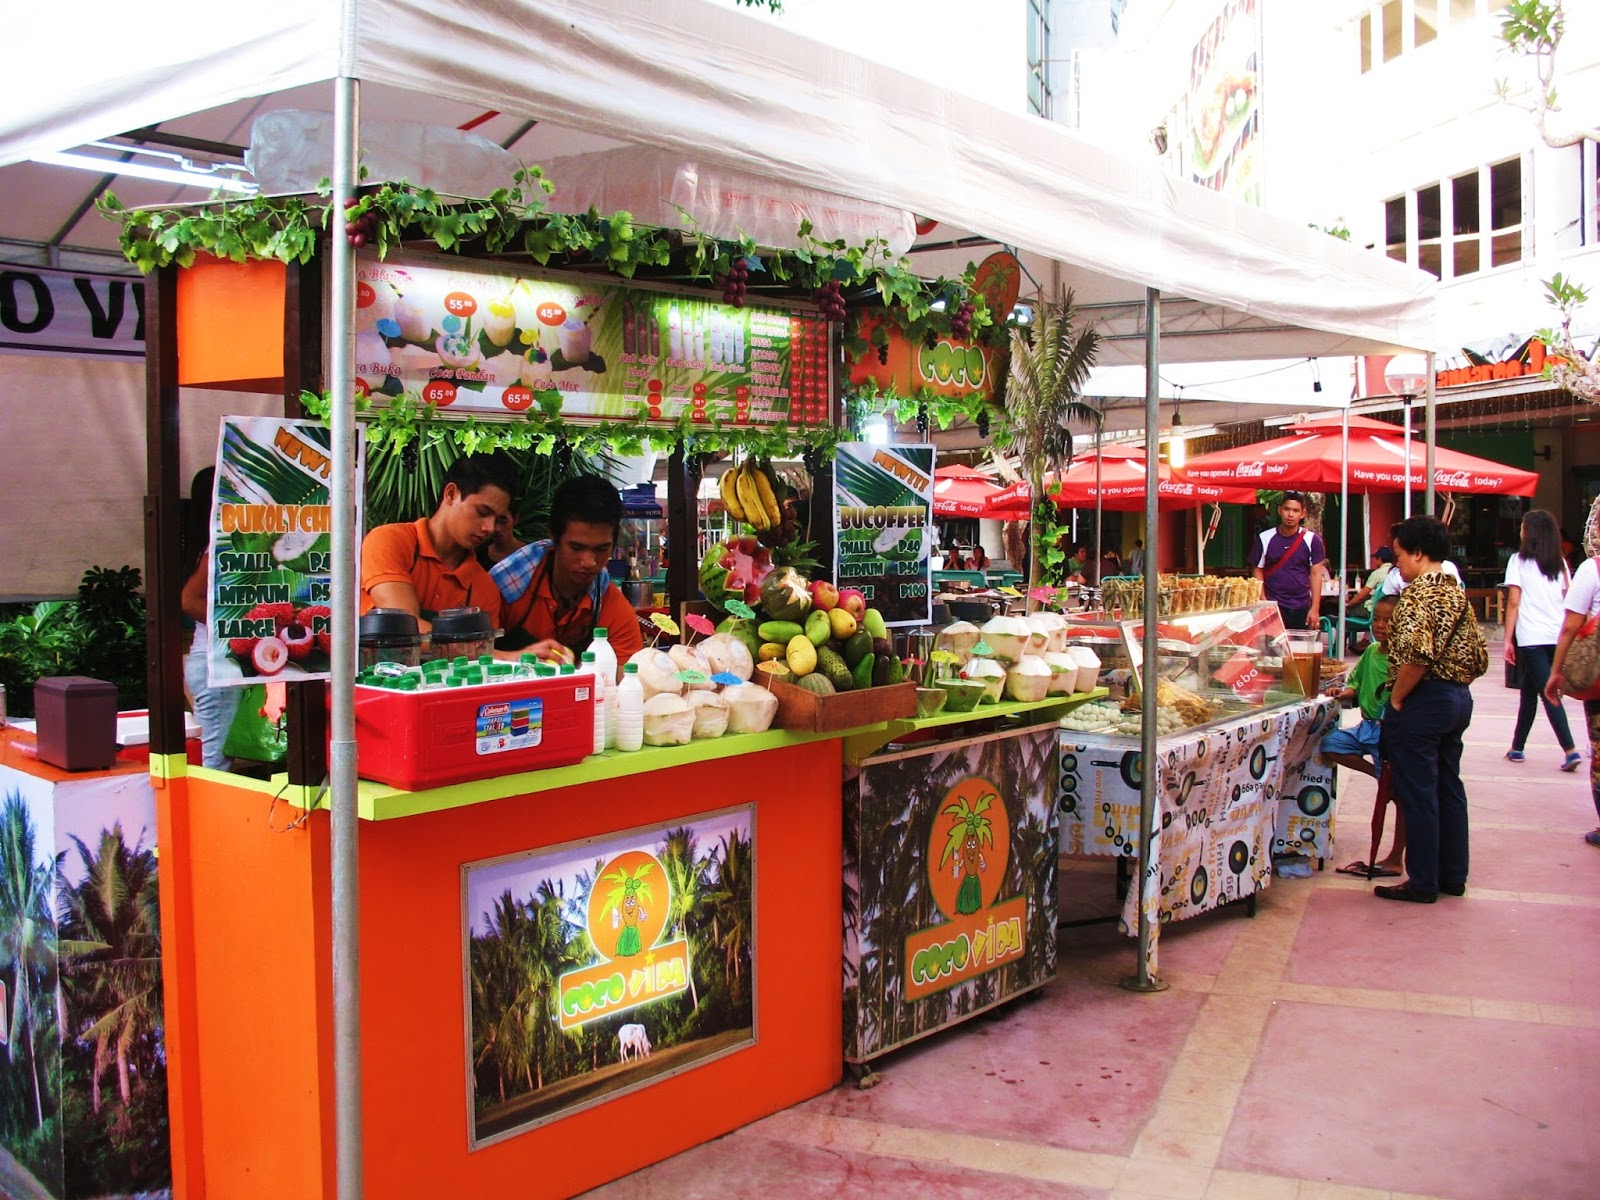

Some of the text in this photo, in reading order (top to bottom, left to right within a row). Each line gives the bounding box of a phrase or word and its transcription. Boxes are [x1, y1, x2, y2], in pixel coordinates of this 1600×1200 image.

[428, 367, 496, 382] Coco Pandan
[533, 378, 580, 392] Coco Mix
[872, 448, 930, 493] NEW!!!
[1266, 463, 1289, 475] today?
[1354, 469, 1375, 480] Have
[1376, 471, 1391, 481] you
[1474, 476, 1502, 488] today?
[1107, 487, 1122, 496] you
[1122, 485, 1145, 495] opene
[1197, 486, 1223, 496] today?
[960, 504, 982, 513] today?
[840, 505, 926, 530] BUCOFFEE
[839, 538, 920, 556] SMALL P40
[218, 551, 330, 574] SMALL P4
[839, 560, 920, 577] MEDIUM P50
[218, 583, 330, 606] MEDIUM P5
[900, 583, 926, 598] P100
[217, 618, 276, 639] LARGE
[483, 706, 504, 716] Coleman
[1300, 773, 1323, 784] fried
[1277, 838, 1302, 849] ovo
[911, 933, 970, 985] COCO
[562, 971, 626, 1017] COCO
